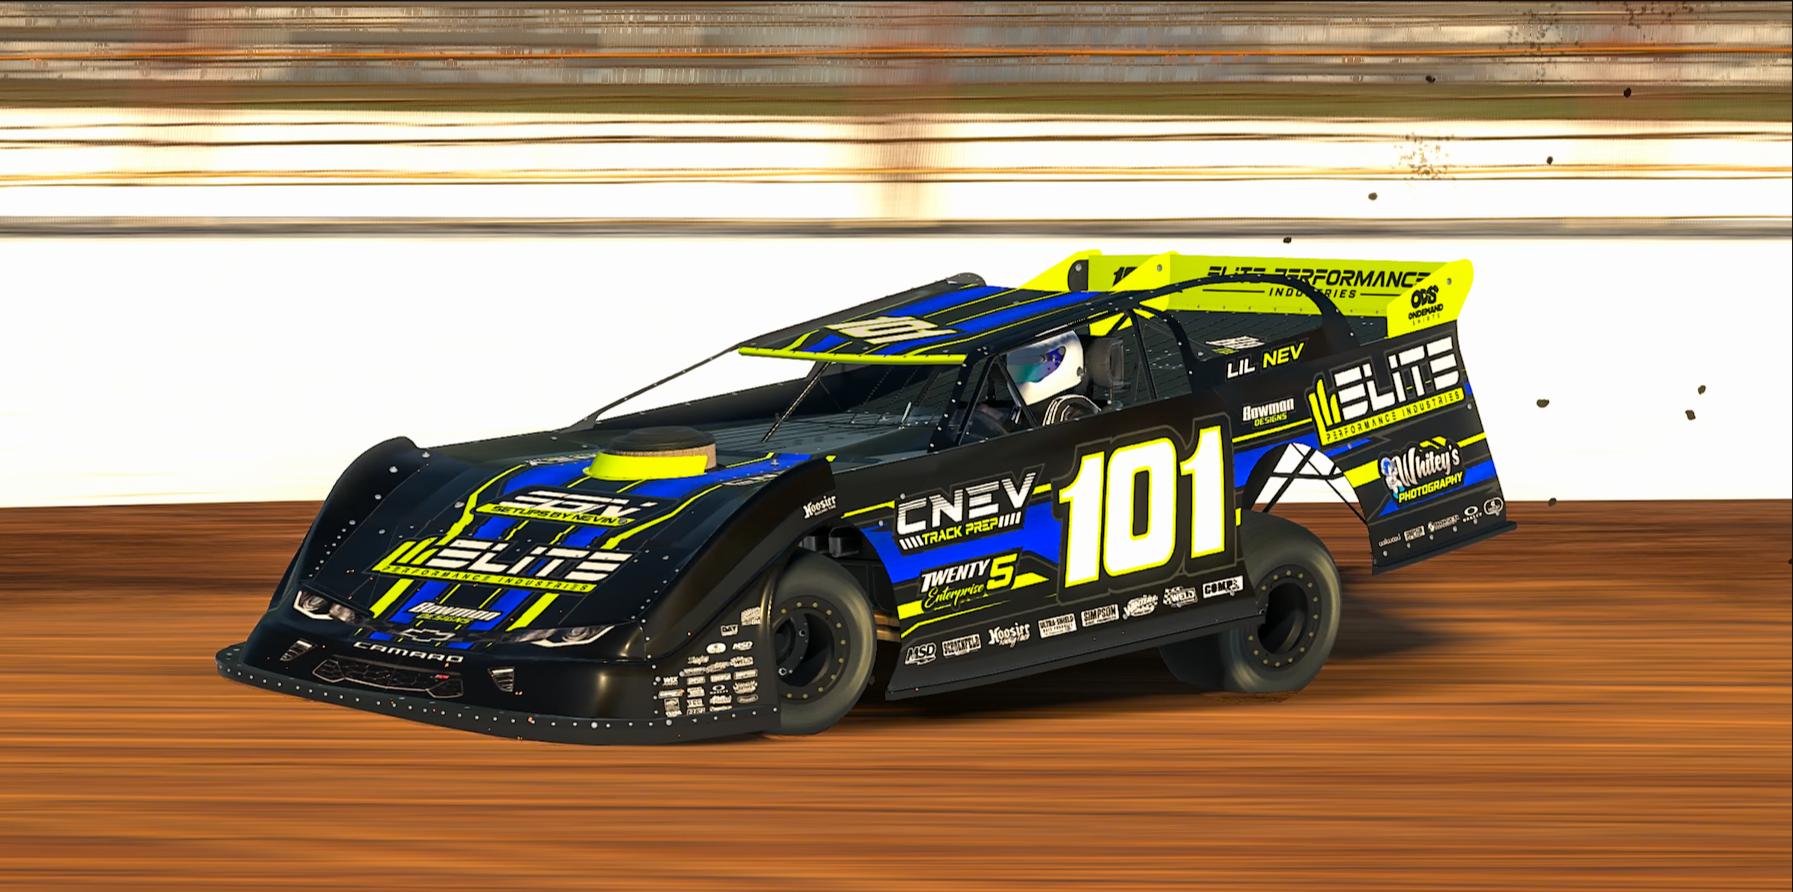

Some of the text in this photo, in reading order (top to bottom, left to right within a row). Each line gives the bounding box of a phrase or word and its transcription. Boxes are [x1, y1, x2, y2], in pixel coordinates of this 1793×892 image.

[1227, 358, 1256, 378] LIL
[1262, 342, 1305, 368] NEV
[1334, 336, 1460, 420] ELITE
[1242, 398, 1295, 421] Bowman
[1254, 412, 1288, 427] DESIGNS
[1326, 390, 1461, 442] PERFORMANCE INDUSTRIES
[1393, 444, 1461, 487] Whitey's
[1398, 471, 1463, 504] PHOTOGRAPHY
[550, 509, 572, 519] BY
[571, 511, 617, 524] NEVIN
[802, 495, 836, 519] Hoosier
[897, 472, 1036, 535] CNEV
[1058, 425, 1225, 588] 101
[922, 517, 999, 545] TRACK PREP
[425, 539, 633, 582] ELITE
[920, 553, 1018, 593] TWENTY 5
[380, 565, 590, 592] PERFORMANCE INDUSTRIES
[924, 583, 984, 608] Enterprise
[1170, 590, 1195, 602] WELD
[1083, 605, 1116, 622] SIMPSON
[988, 622, 1031, 645] Hoosier
[353, 641, 464, 663] CAMARO
[905, 643, 936, 662] MSD
